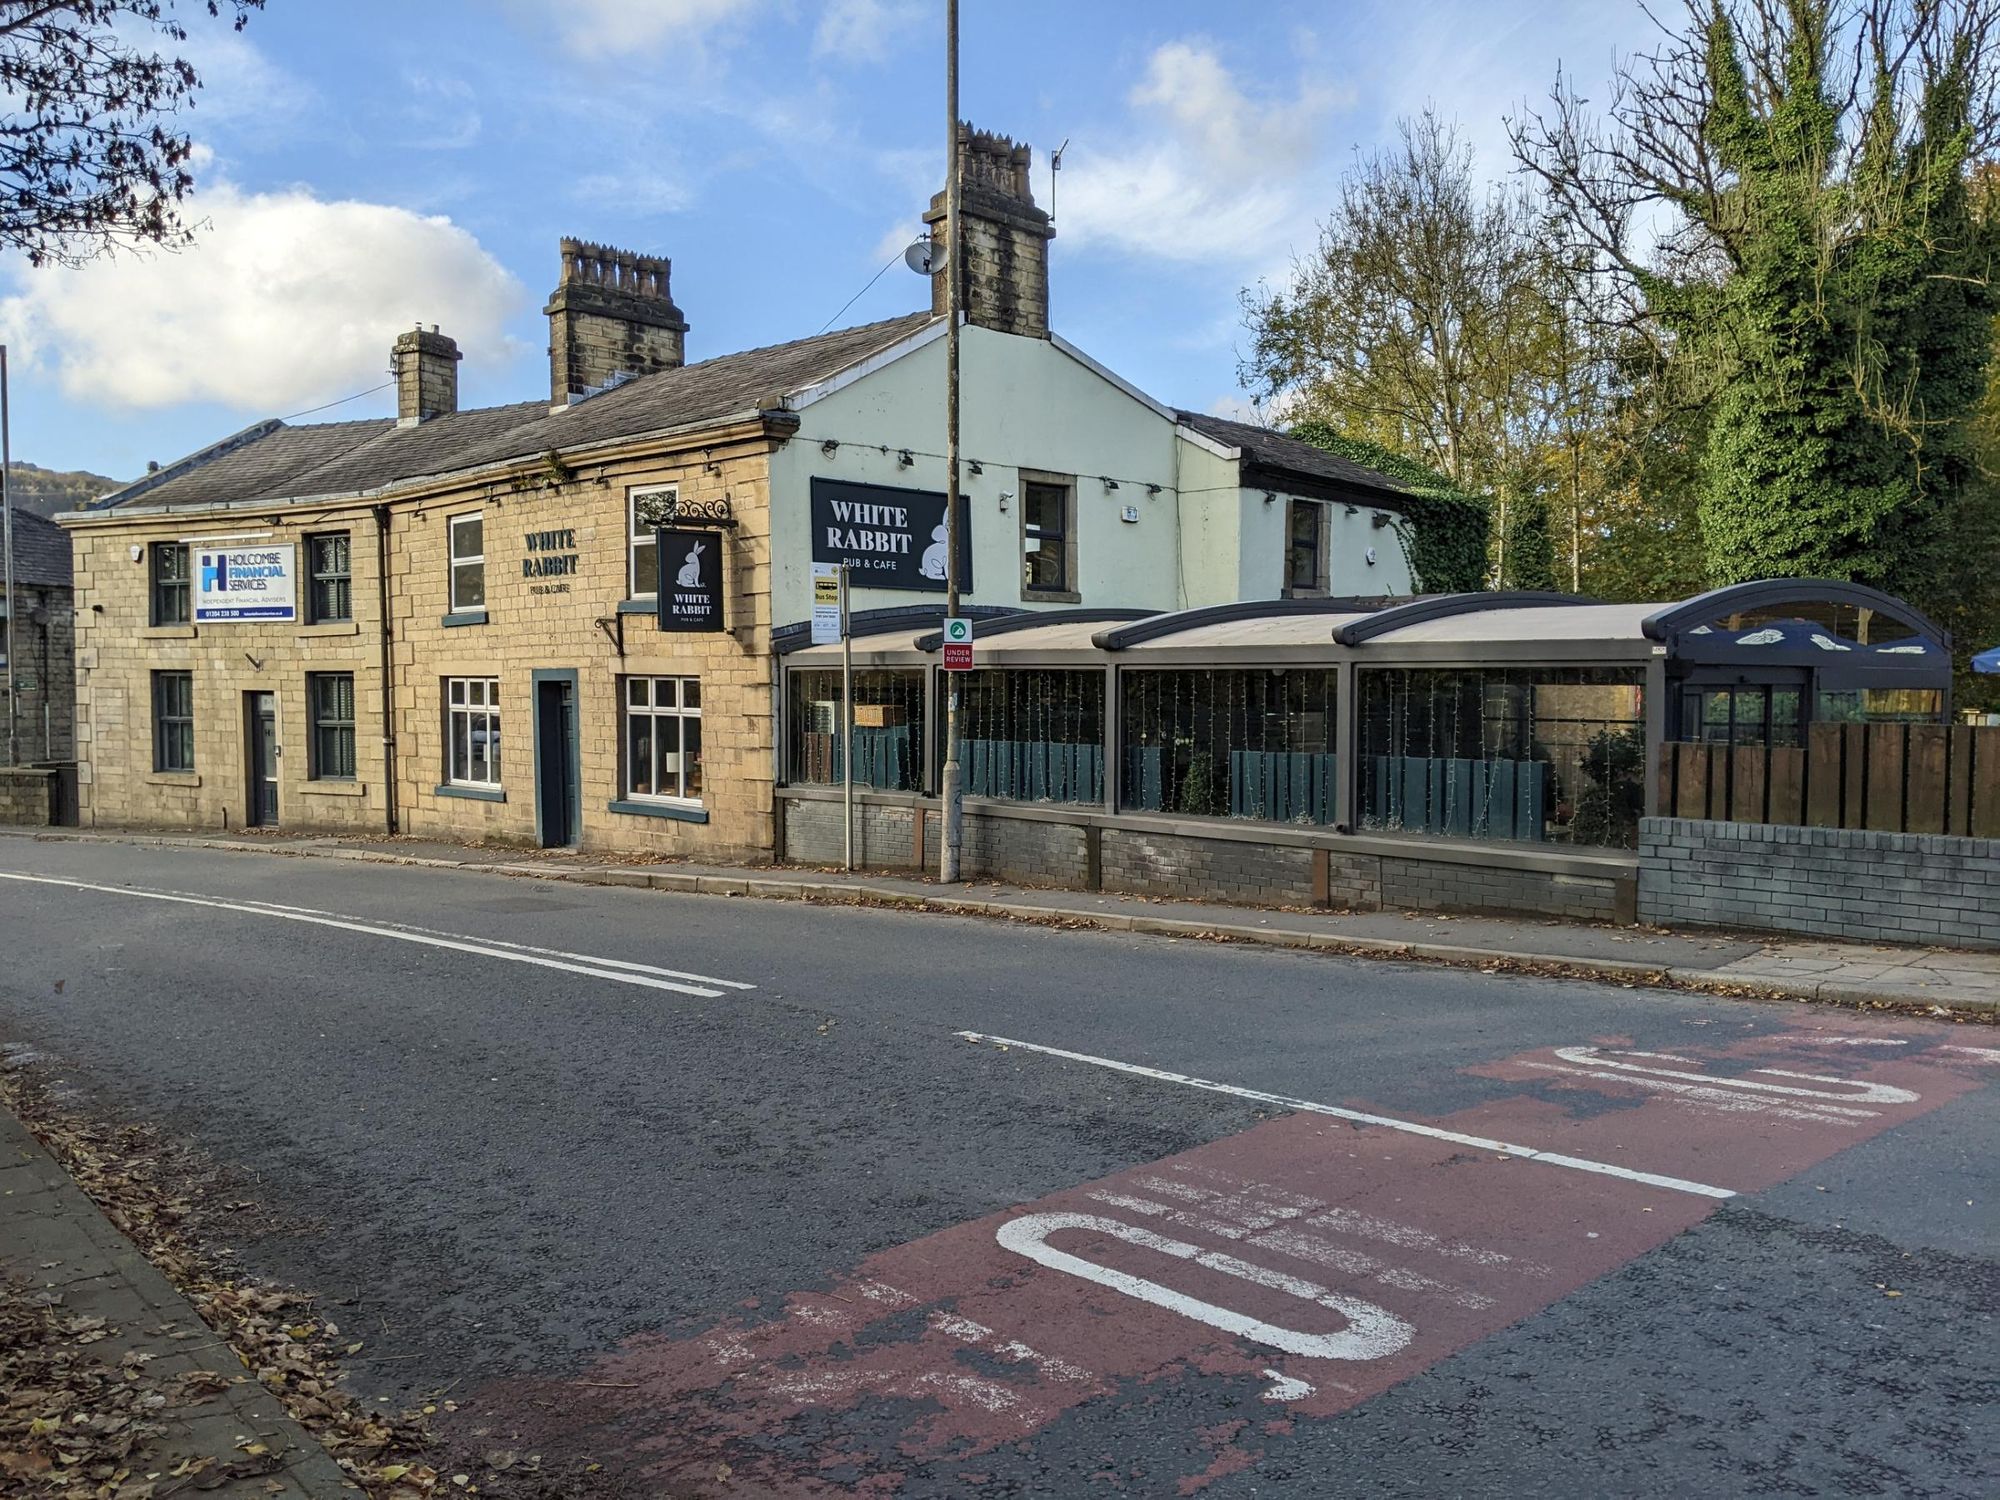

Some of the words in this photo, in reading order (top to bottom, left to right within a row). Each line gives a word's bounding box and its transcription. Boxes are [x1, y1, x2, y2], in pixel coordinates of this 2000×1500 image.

[830, 500, 908, 528] WHITE
[525, 528, 576, 551] WHITE
[826, 526, 913, 554] RABBIT
[228, 552, 281, 566] HOLCOMBE
[843, 557, 861, 568] PUB
[863, 559, 871, 569] &
[873, 559, 897, 570] CAFE
[228, 566, 287, 579] FINANCIAL
[522, 554, 579, 578] RABBIT
[228, 579, 268, 592] SERVICES
[674, 593, 711, 605] WHITE
[815, 593, 825, 601] Bus
[826, 593, 838, 602] Stop
[672, 605, 713, 616] RABBIT
